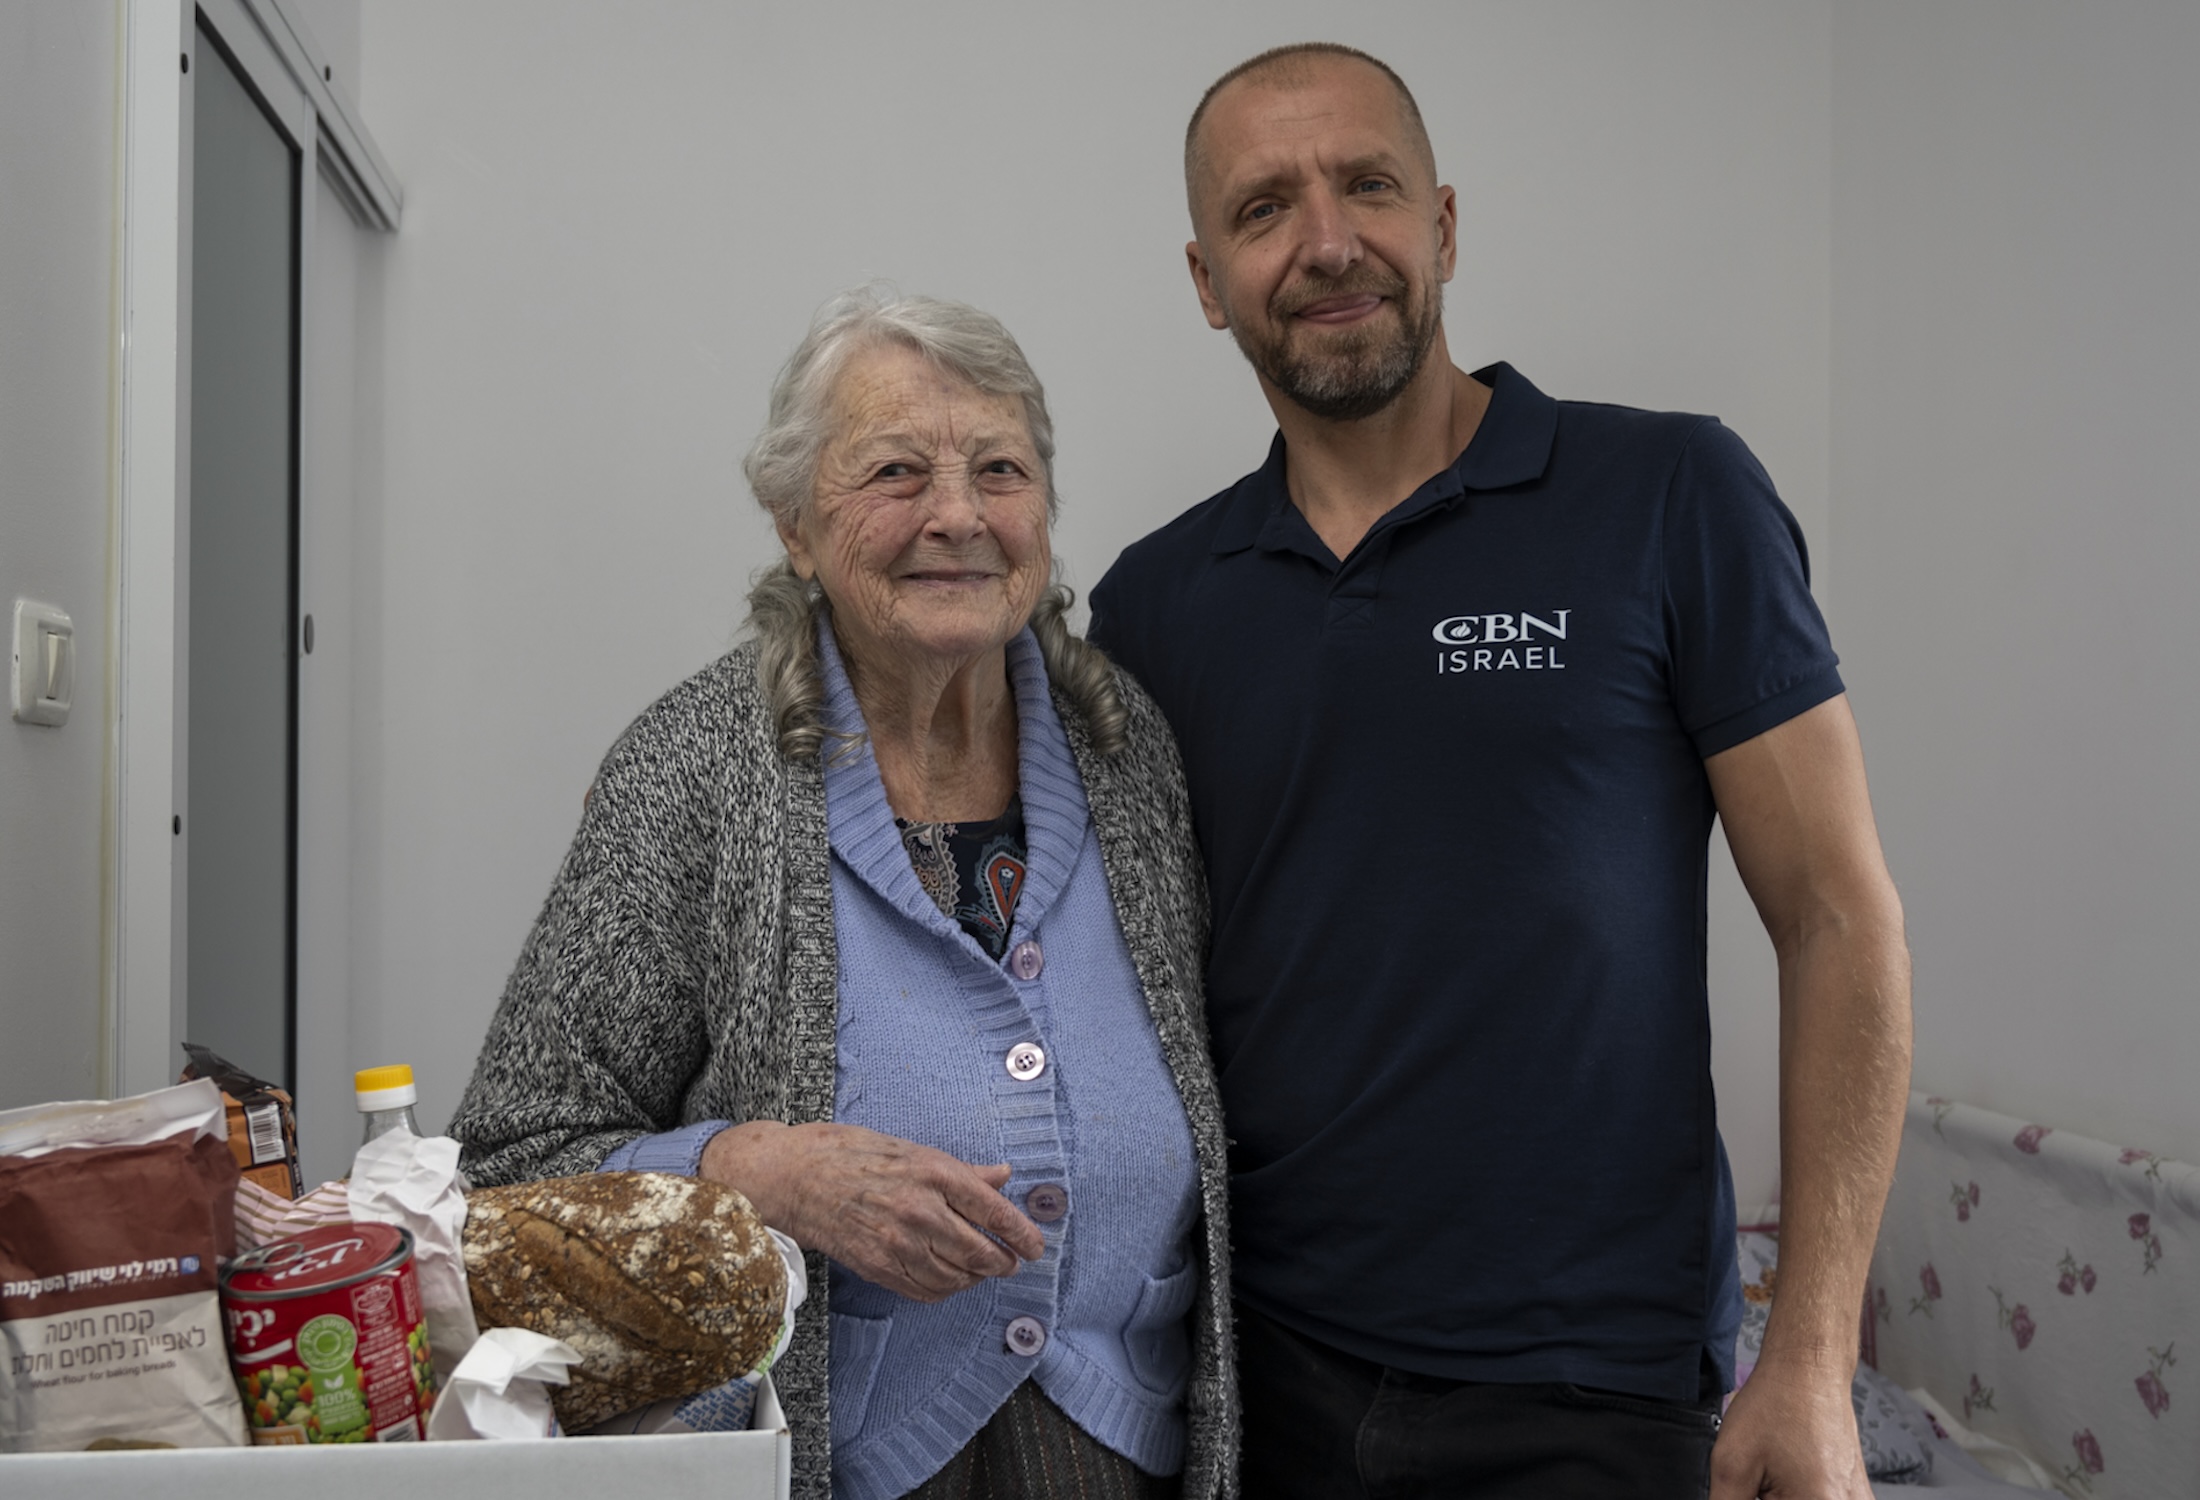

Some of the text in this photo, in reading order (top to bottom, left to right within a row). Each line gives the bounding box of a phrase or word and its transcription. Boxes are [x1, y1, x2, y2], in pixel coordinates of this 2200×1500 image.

[1432, 609, 1571, 645] CBN
[1438, 647, 1565, 674] ISRAEL
[119, 1261, 144, 1278] לוי
[146, 1257, 178, 1273] רמי
[3, 1275, 66, 1299] השקמה
[66, 1266, 116, 1292] שיווק
[45, 1309, 154, 1344] קמח חיטה
[60, 1338, 126, 1369] לחמים
[132, 1325, 206, 1358] לאפיית
[31, 1378, 61, 1390] Wheat
[62, 1373, 87, 1386] flour
[90, 1370, 104, 1380] for
[106, 1364, 141, 1379] baking
[317, 1387, 357, 1408] 100%
